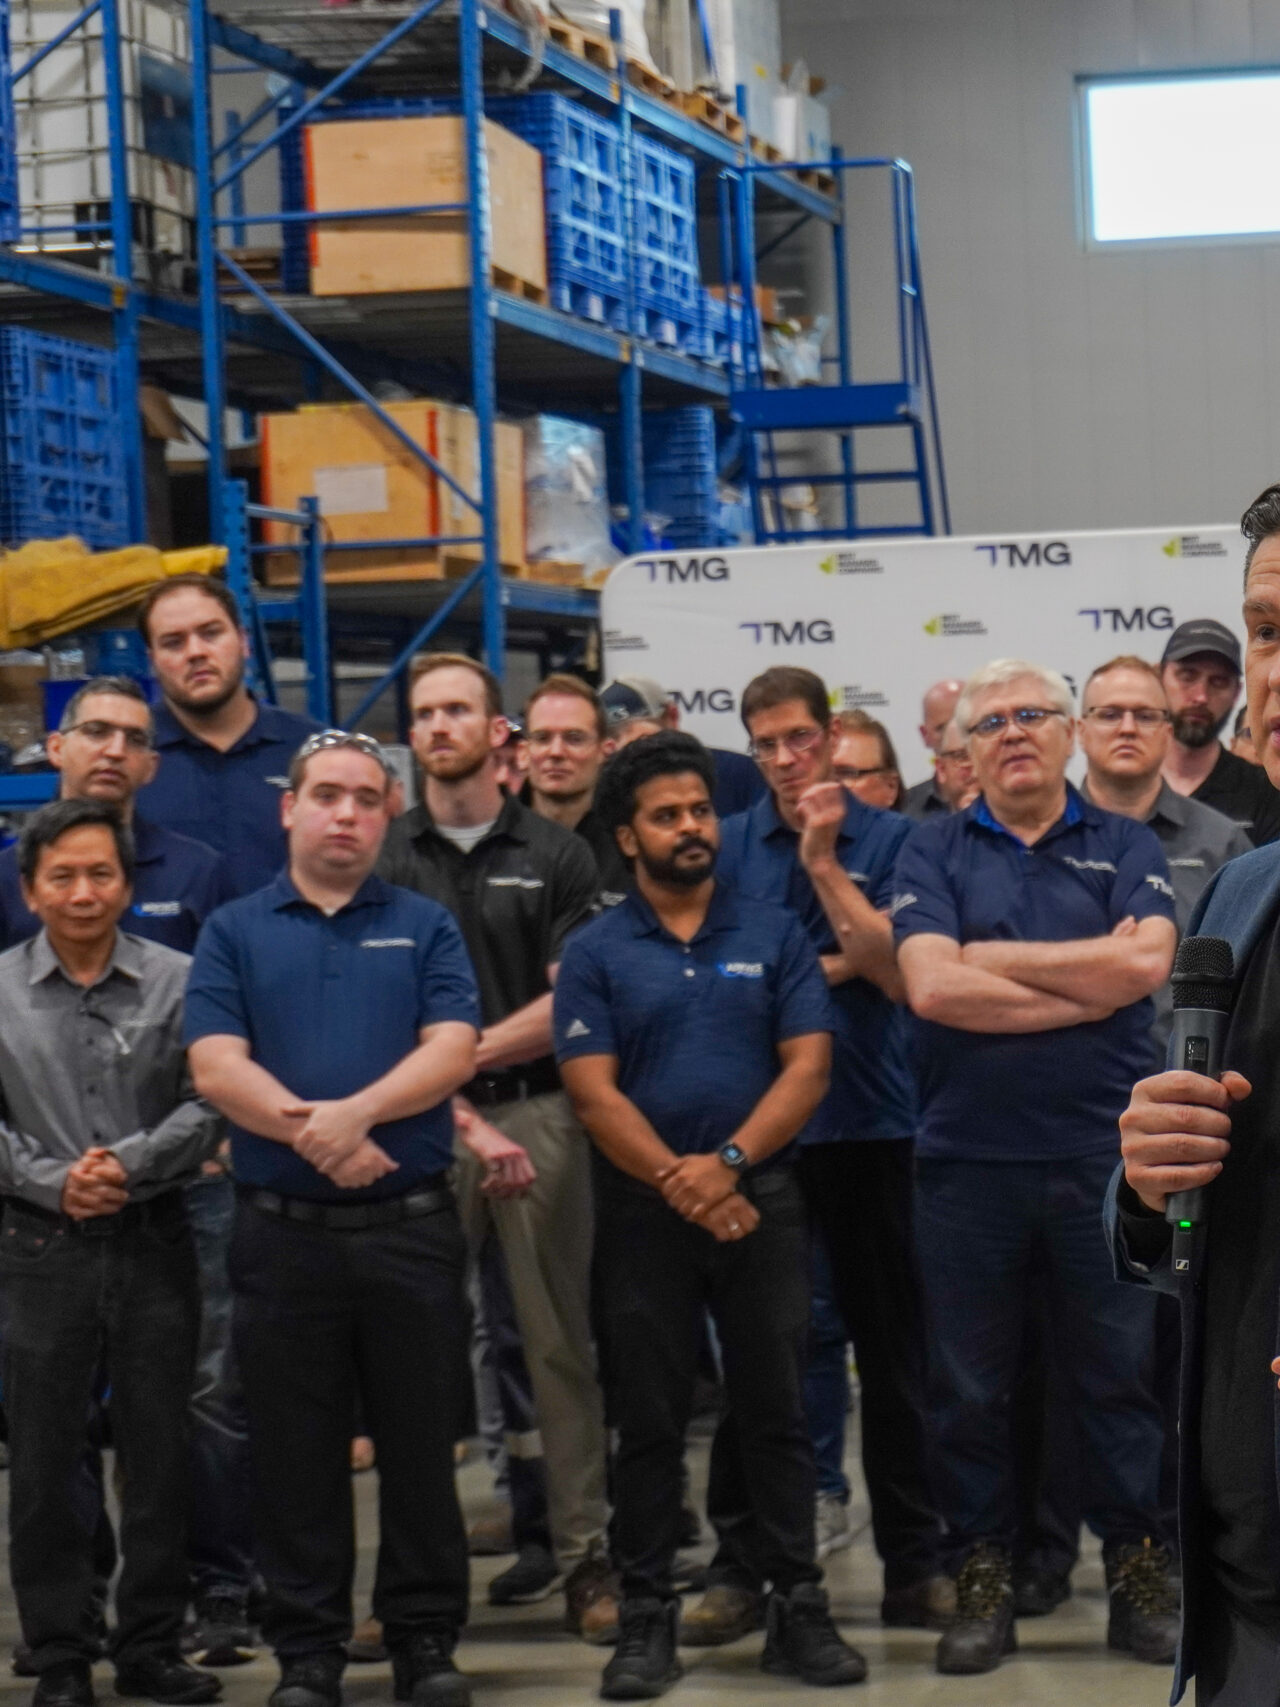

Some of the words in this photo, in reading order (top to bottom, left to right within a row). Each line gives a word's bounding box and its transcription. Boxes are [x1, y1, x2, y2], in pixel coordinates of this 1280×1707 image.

[998, 541, 1072, 569] TMG
[657, 556, 730, 584] TMG
[1102, 605, 1174, 632] TMG
[762, 619, 834, 646] TMG
